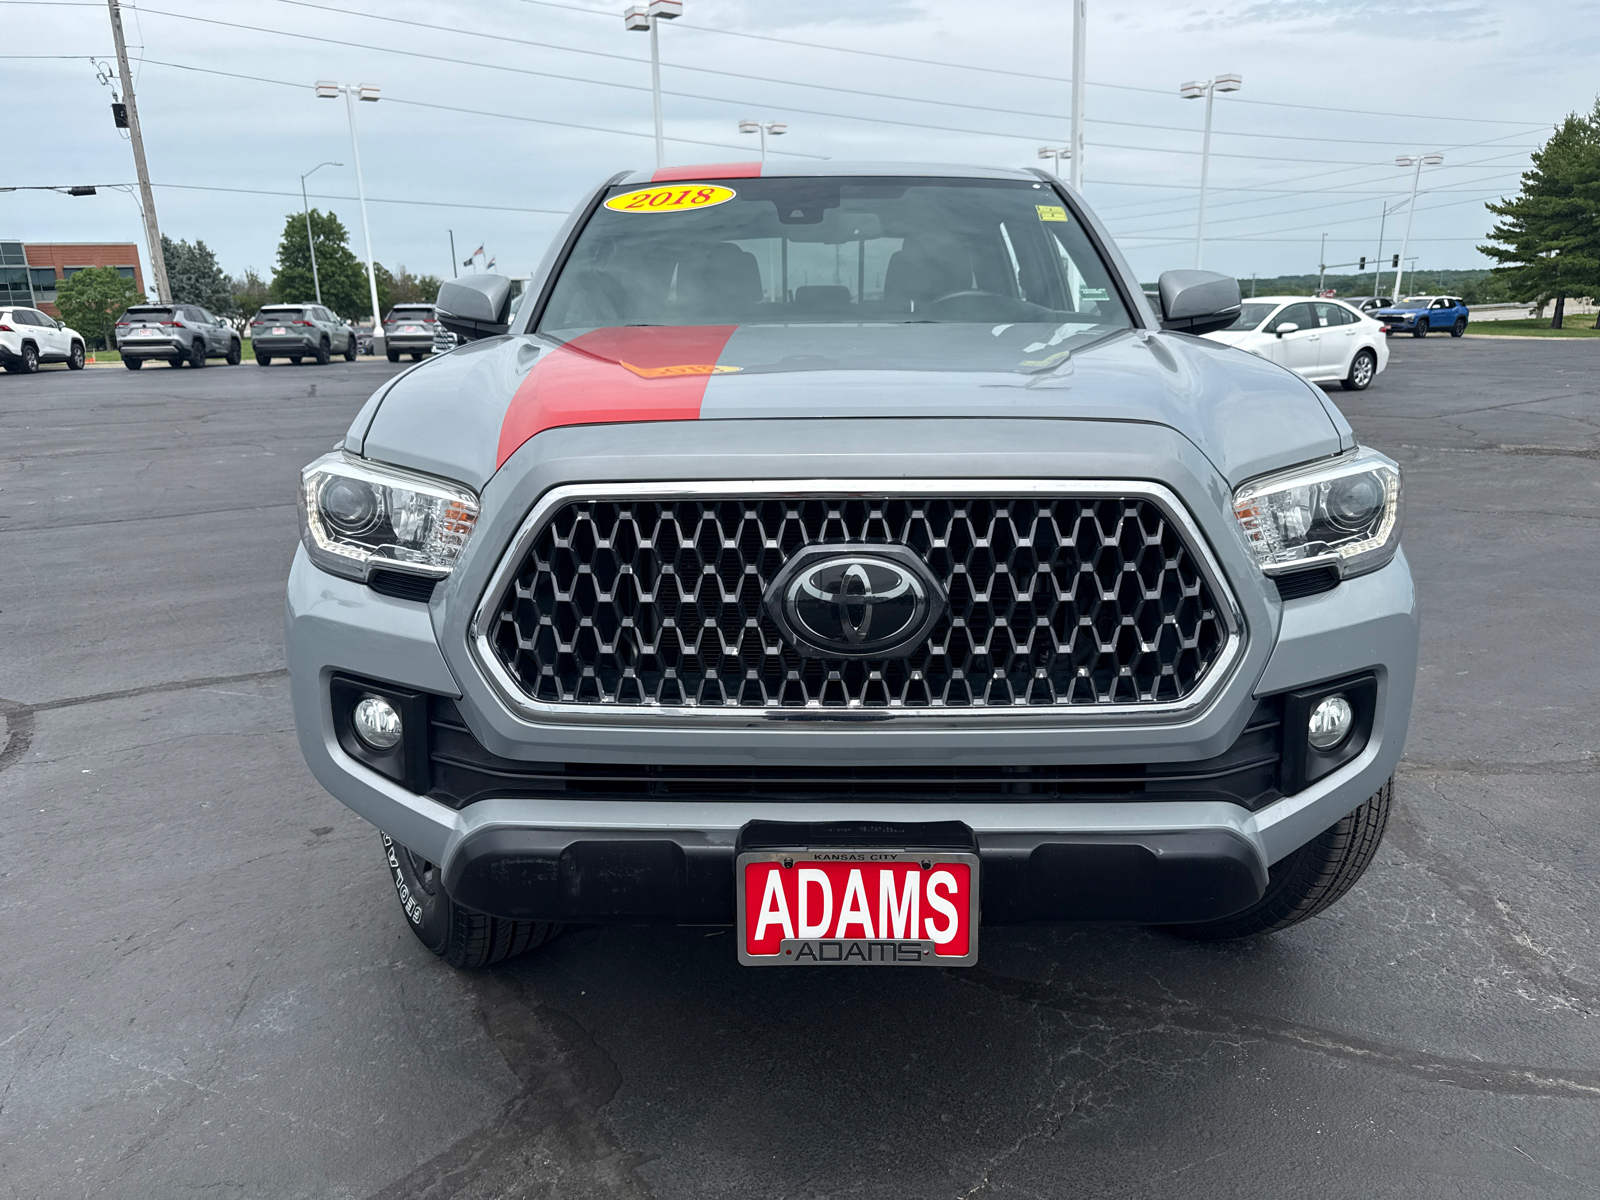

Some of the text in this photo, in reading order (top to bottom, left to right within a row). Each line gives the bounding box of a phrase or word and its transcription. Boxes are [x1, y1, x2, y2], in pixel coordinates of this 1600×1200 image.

[624, 188, 715, 209] 2018
[754, 868, 959, 944] ADAMS
[794, 942, 922, 962] ADAMS
